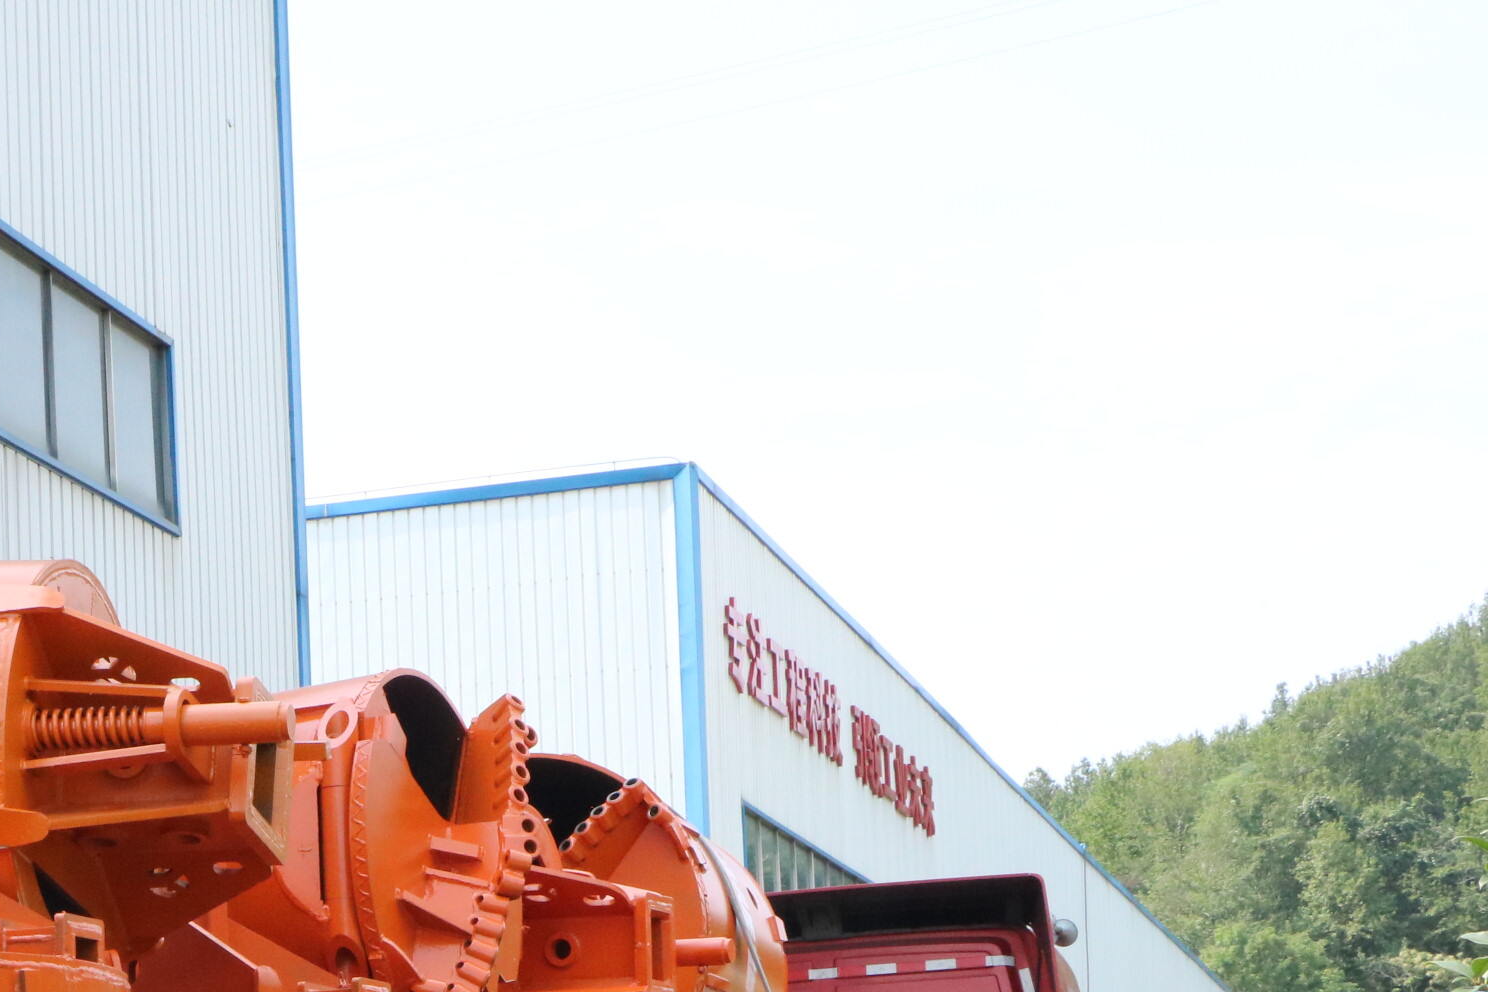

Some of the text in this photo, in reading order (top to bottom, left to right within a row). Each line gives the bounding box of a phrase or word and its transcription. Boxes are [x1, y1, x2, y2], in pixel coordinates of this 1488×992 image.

[722, 596, 844, 768] 专注工程科技
